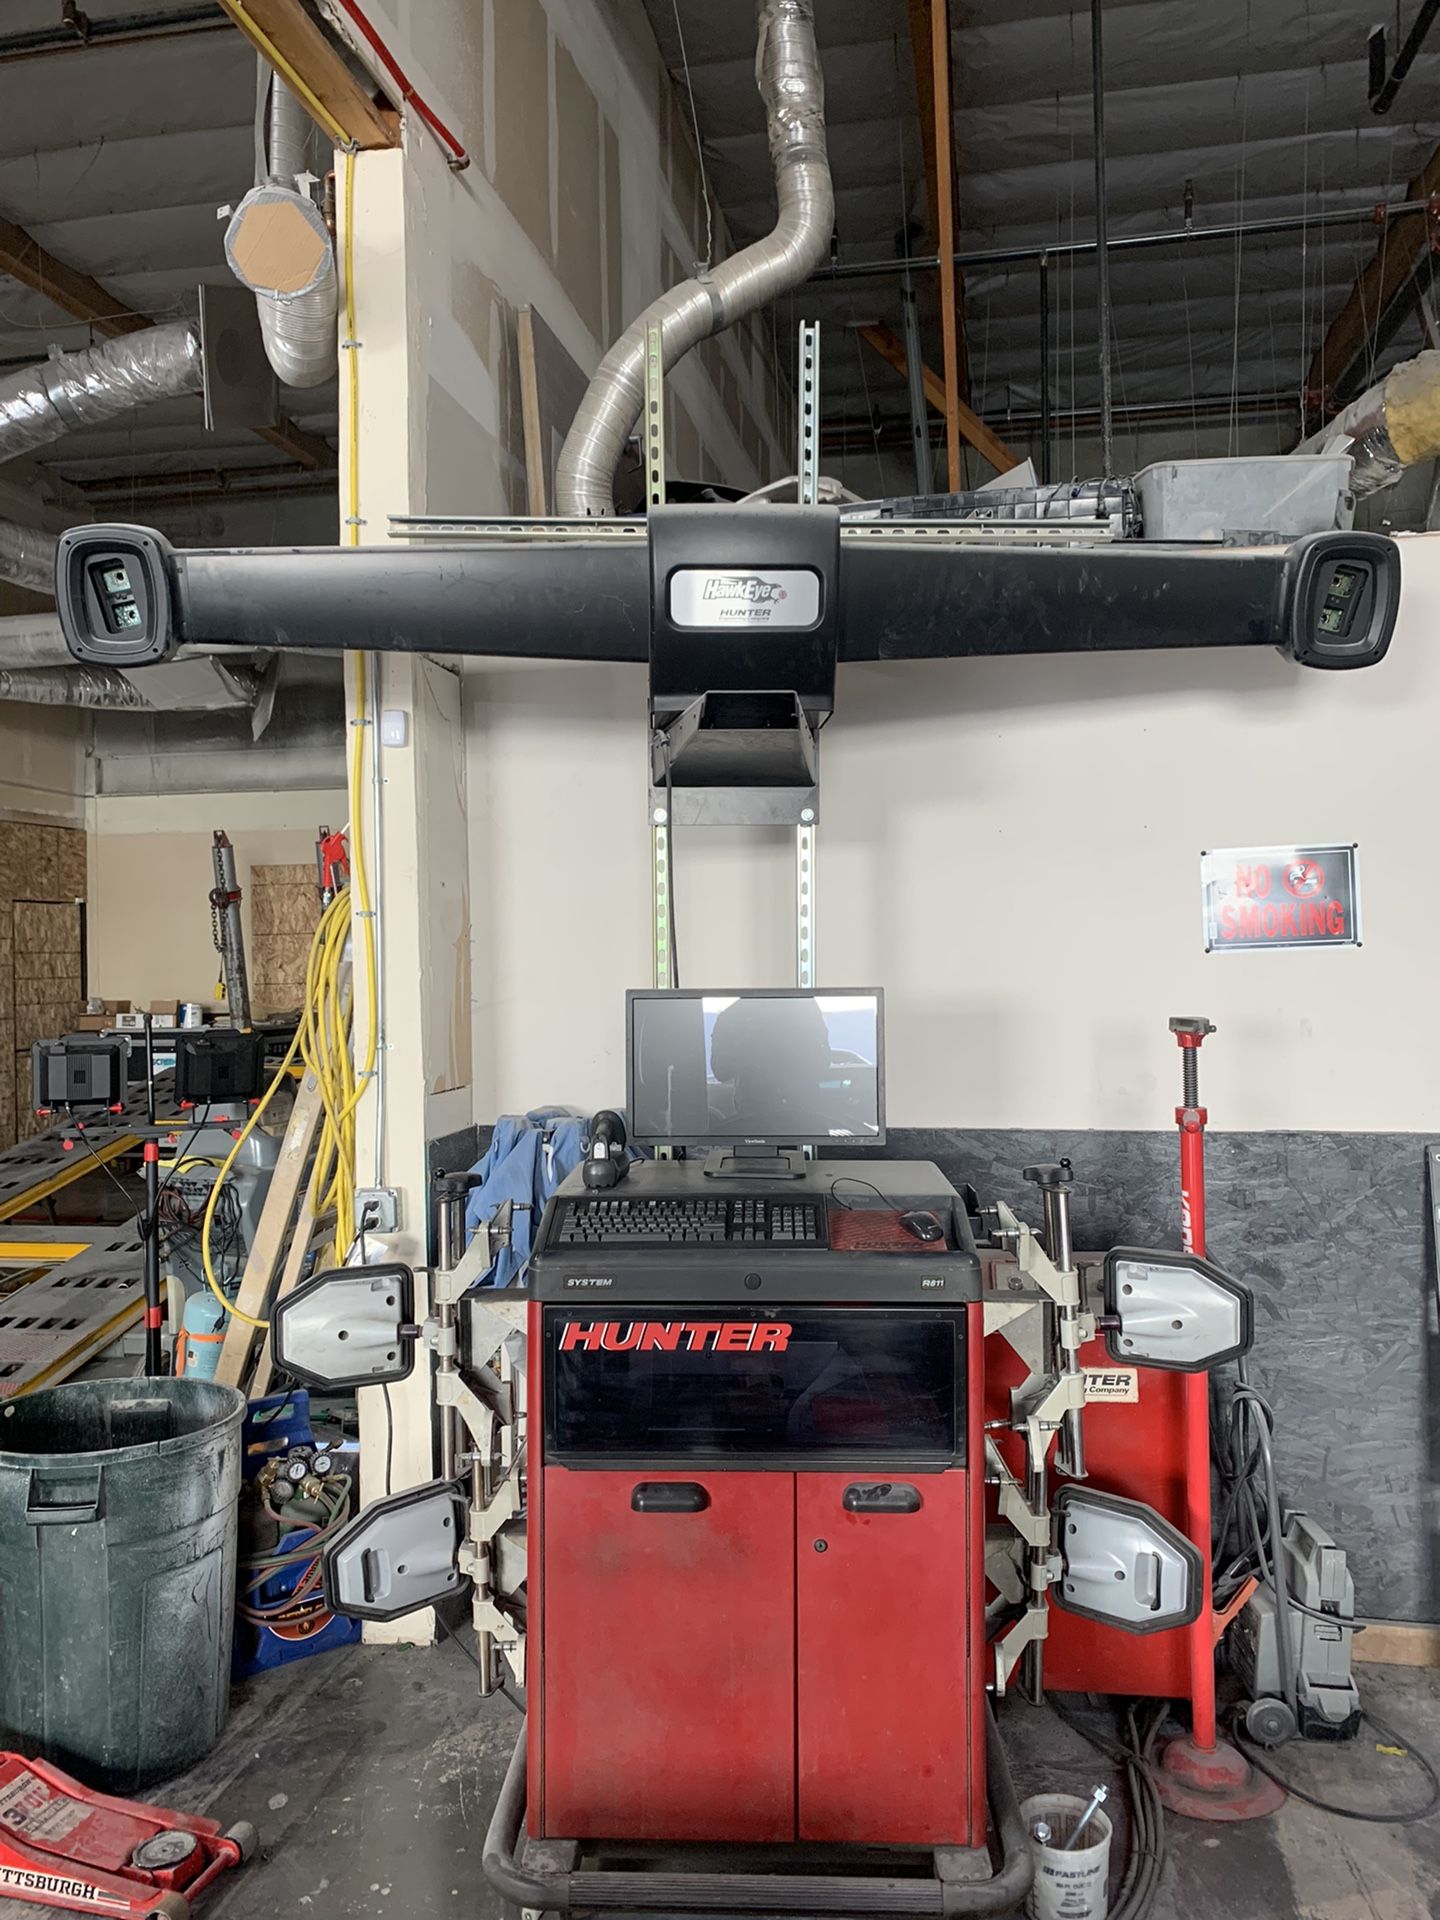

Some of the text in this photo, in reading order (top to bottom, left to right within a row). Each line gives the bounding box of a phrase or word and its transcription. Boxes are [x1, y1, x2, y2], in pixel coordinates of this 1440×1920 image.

[703, 577, 770, 601] HawkEye
[1236, 864, 1271, 898] NO
[1221, 900, 1345, 939] SMOKING
[567, 1278, 613, 1287] SYSTEM
[921, 1279, 944, 1287] R811
[558, 1322, 793, 1351] HUNTER
[1084, 1374, 1131, 1386] TER
[1089, 1386, 1130, 1395] Company
[0, 1867, 97, 1900] TTSBURGH
